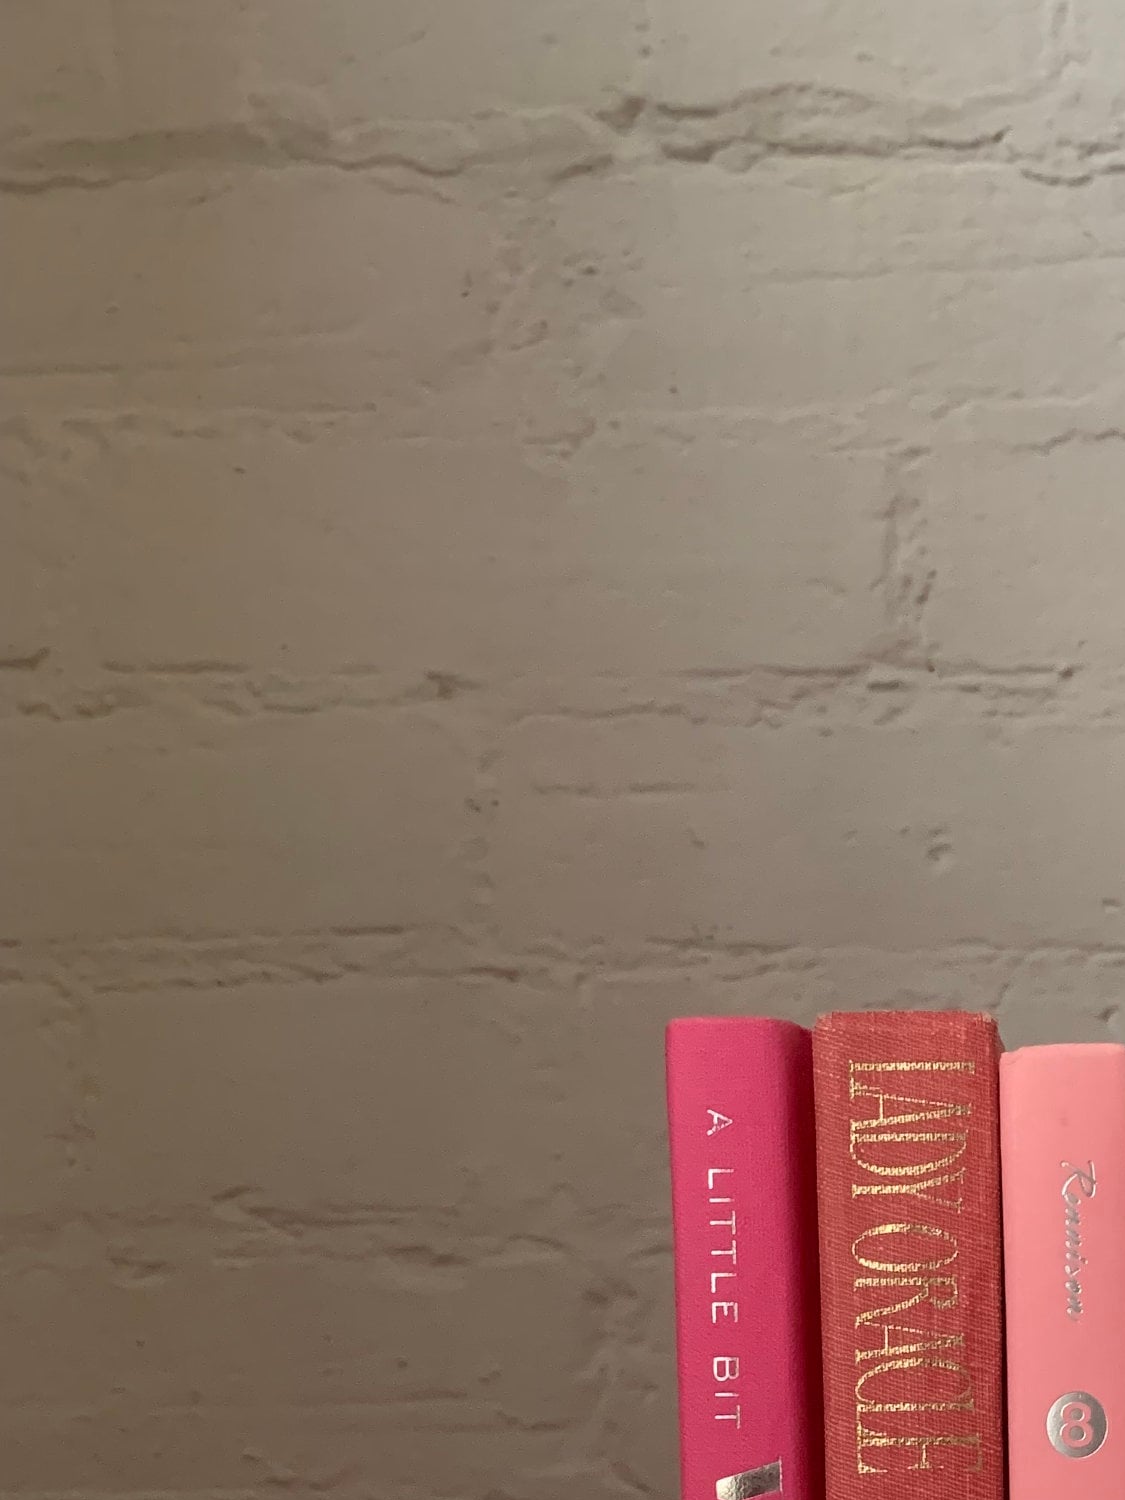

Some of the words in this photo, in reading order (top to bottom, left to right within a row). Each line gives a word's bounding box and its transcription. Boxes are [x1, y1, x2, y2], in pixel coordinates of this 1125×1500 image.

[706, 1109, 734, 1136] A
[849, 1059, 976, 1214] LADY
[706, 1168, 740, 1323] LITTLE
[1061, 1159, 1097, 1322] Rennison
[712, 1356, 742, 1430] BIT
[852, 1222, 984, 1475] ORACLE
